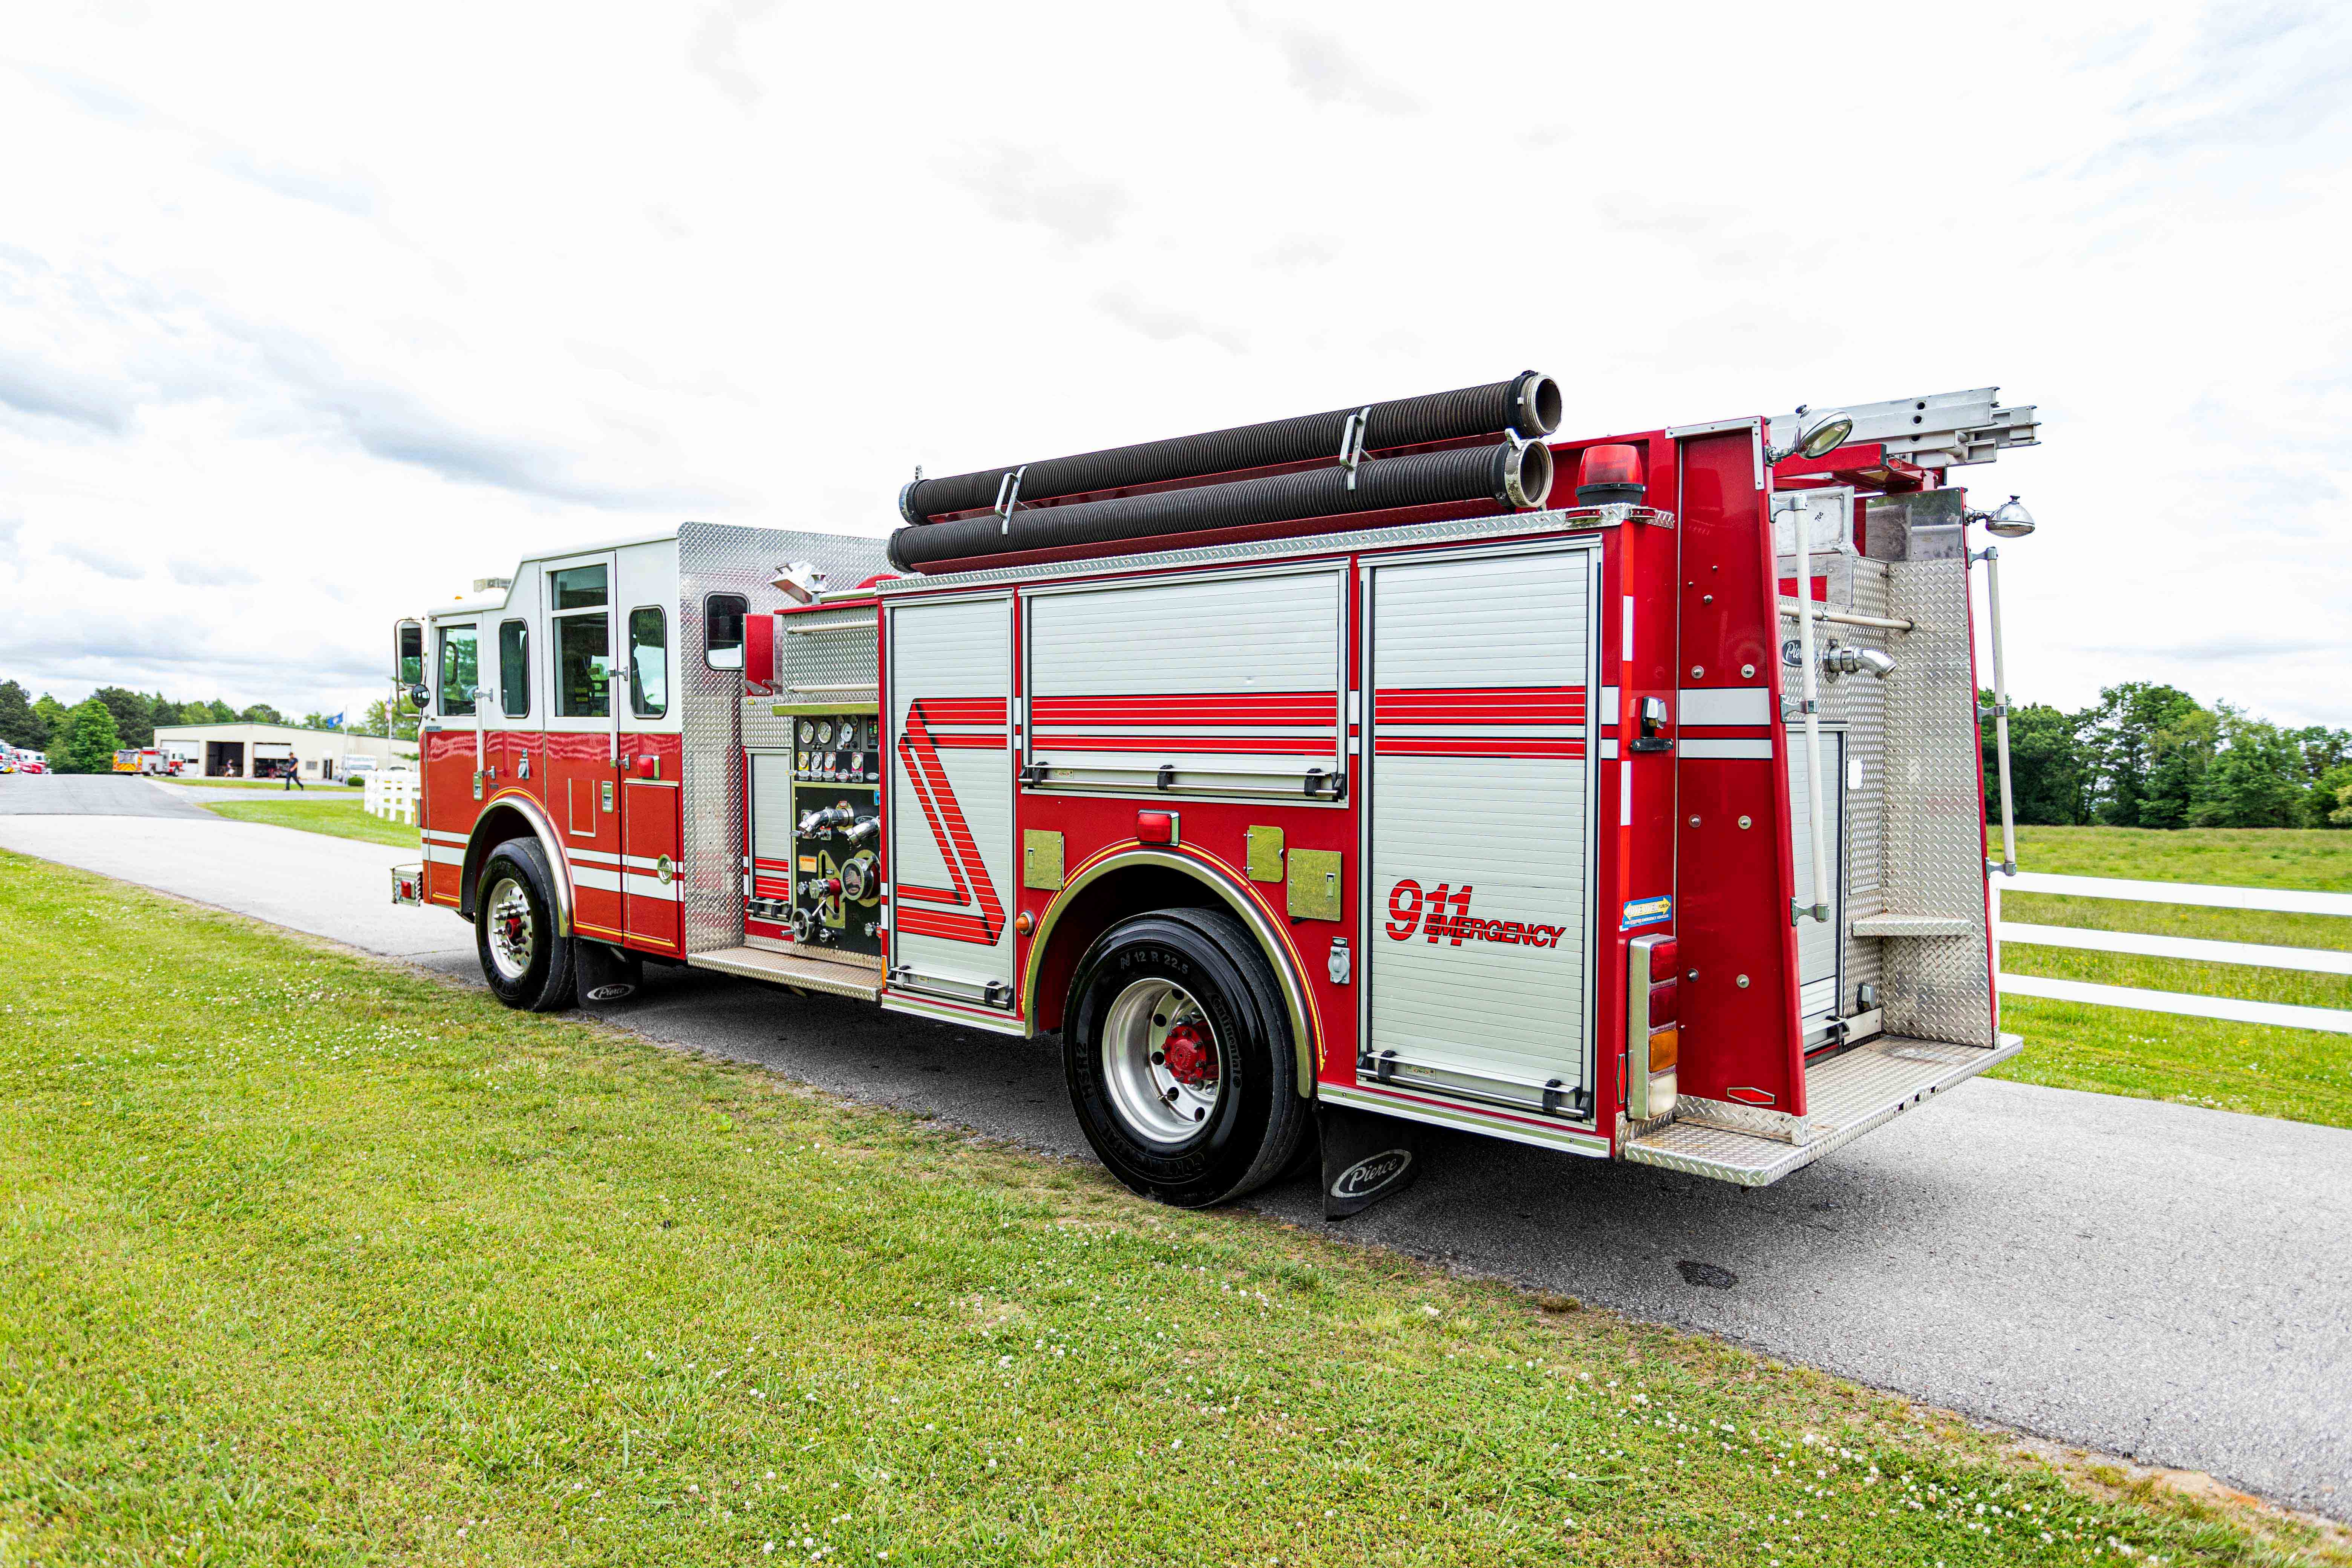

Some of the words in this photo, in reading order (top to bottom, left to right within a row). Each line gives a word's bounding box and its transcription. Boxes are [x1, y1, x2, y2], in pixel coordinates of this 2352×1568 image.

[1785, 642, 1802, 661] Pie
[1385, 879, 1473, 946] 911
[1627, 905, 1642, 916] MOVE
[1643, 903, 1658, 913] OVER
[1422, 914, 1566, 948] EMERGENCY
[1134, 951, 1146, 962] 12
[1151, 951, 1158, 962] R
[1164, 954, 1188, 974] 22.5
[1348, 1158, 1397, 1191] Pierce
